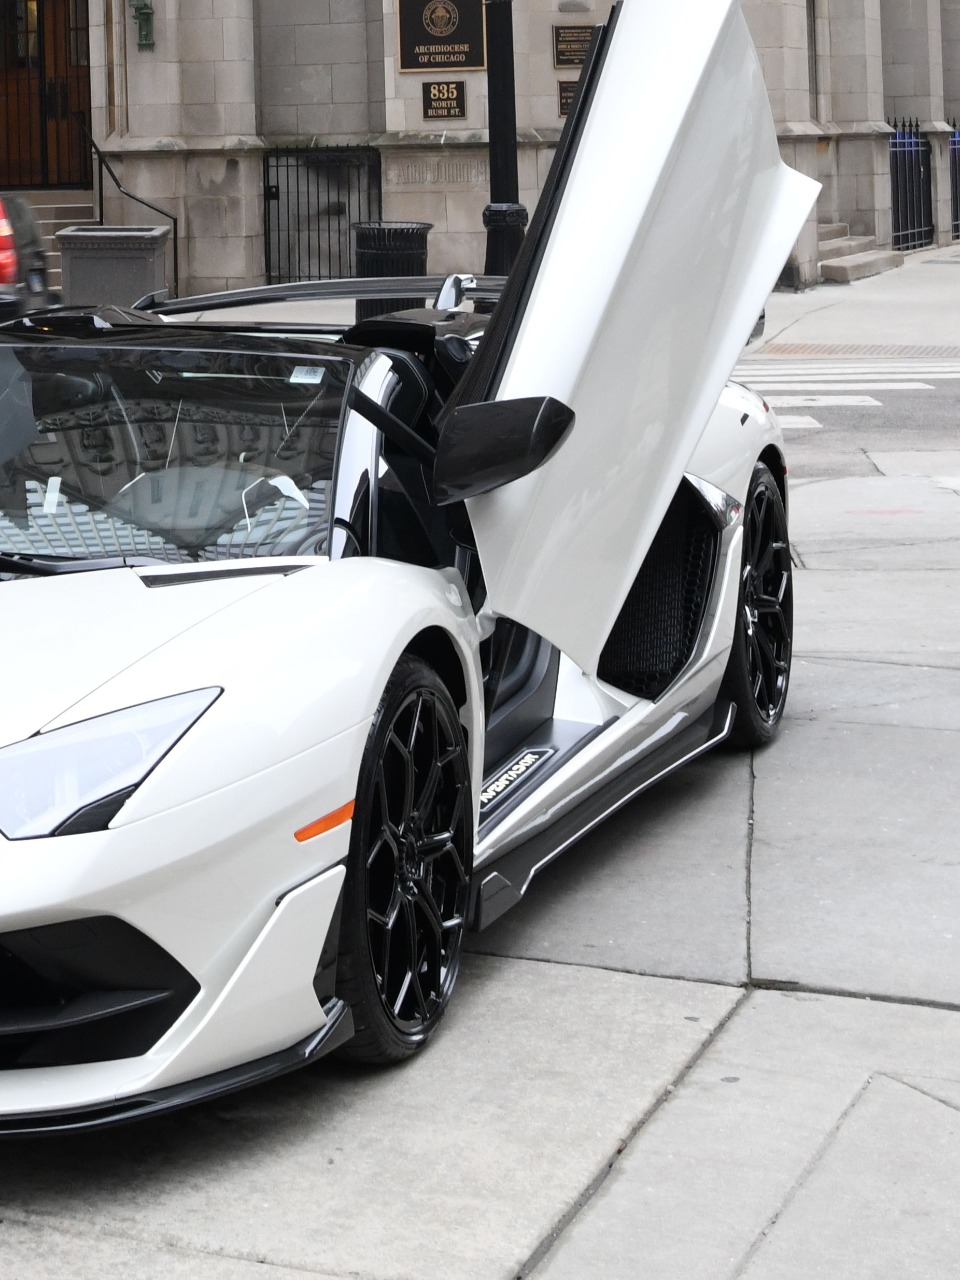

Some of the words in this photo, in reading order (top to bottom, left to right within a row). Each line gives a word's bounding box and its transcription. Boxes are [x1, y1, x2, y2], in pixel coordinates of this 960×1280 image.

[414, 44, 470, 54] ARCHDIOCESE
[418, 55, 430, 63] OF
[430, 54, 466, 63] CHICAGO
[430, 84, 458, 99] 835
[431, 100, 457, 108] NORTH
[450, 108, 461, 116] ST.
